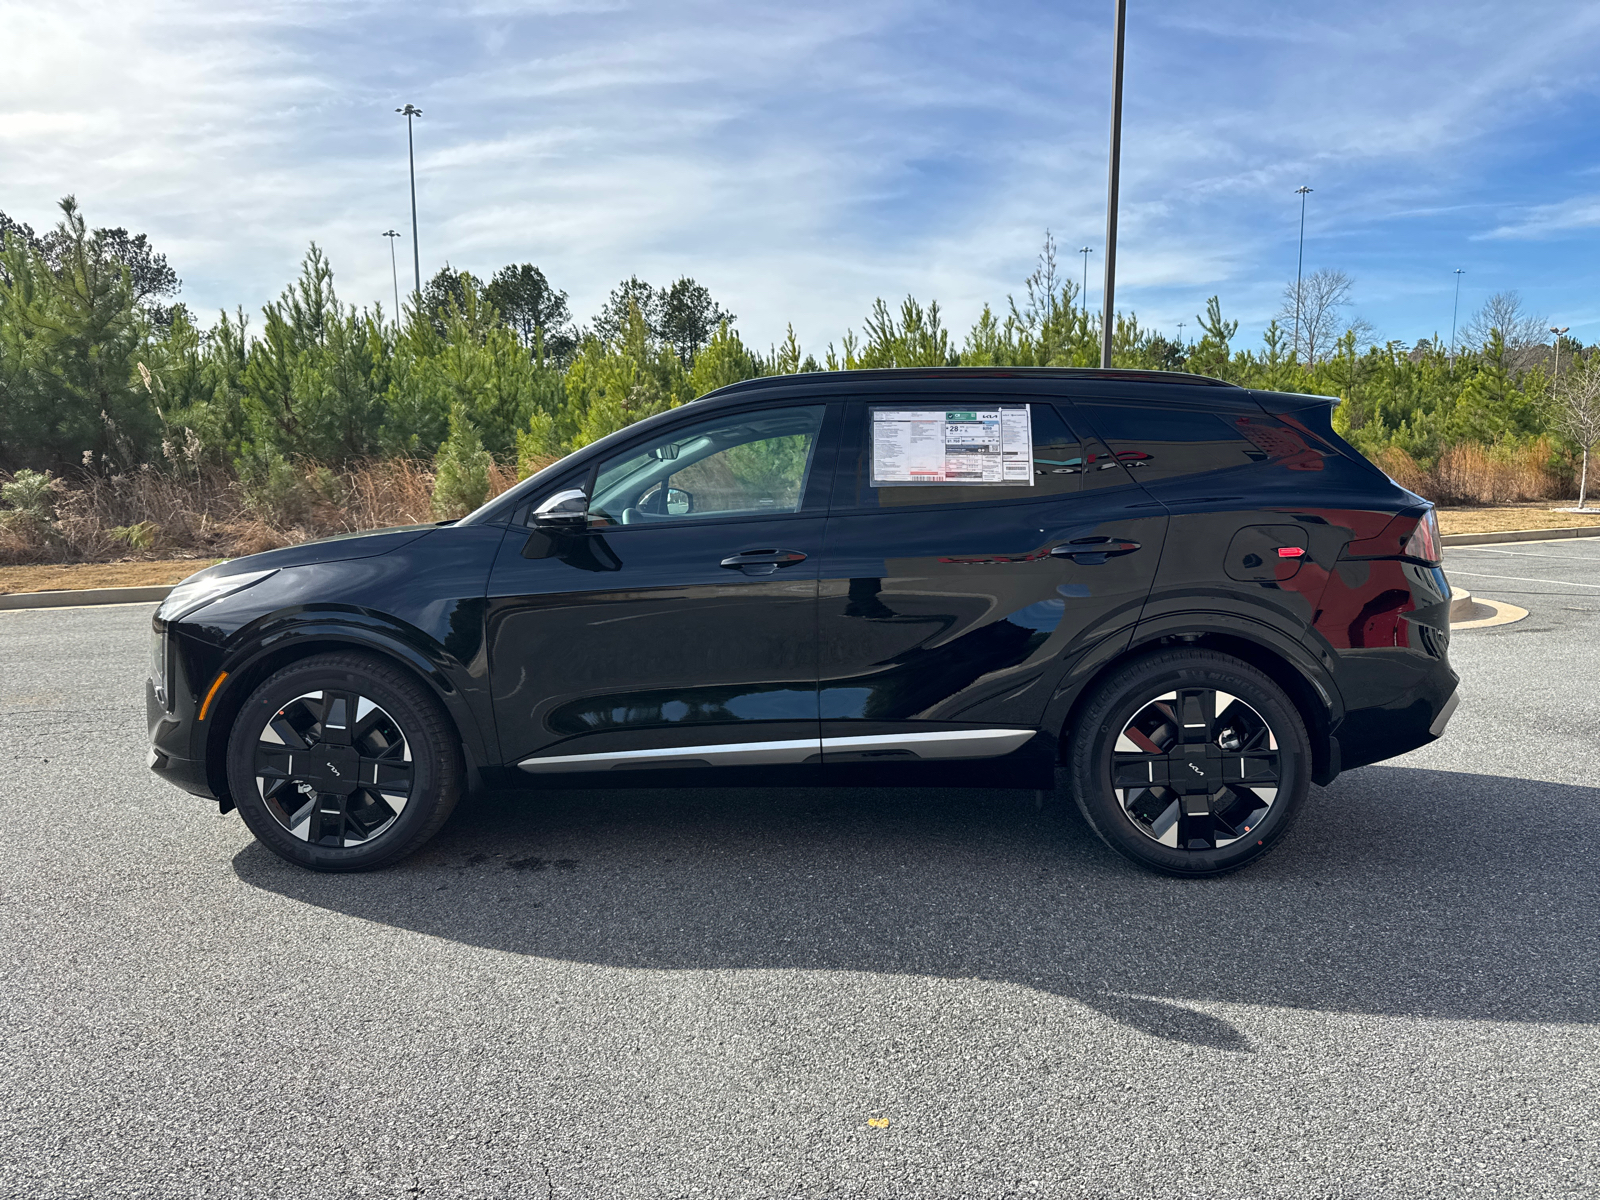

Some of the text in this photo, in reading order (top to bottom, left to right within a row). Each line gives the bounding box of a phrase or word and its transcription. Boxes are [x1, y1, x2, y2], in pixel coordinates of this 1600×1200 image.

[1207, 672, 1266, 702] MICHELIN
[326, 762, 341, 777] KIA
[1188, 762, 1205, 777] KIA
[247, 806, 295, 852] MICHELIN
